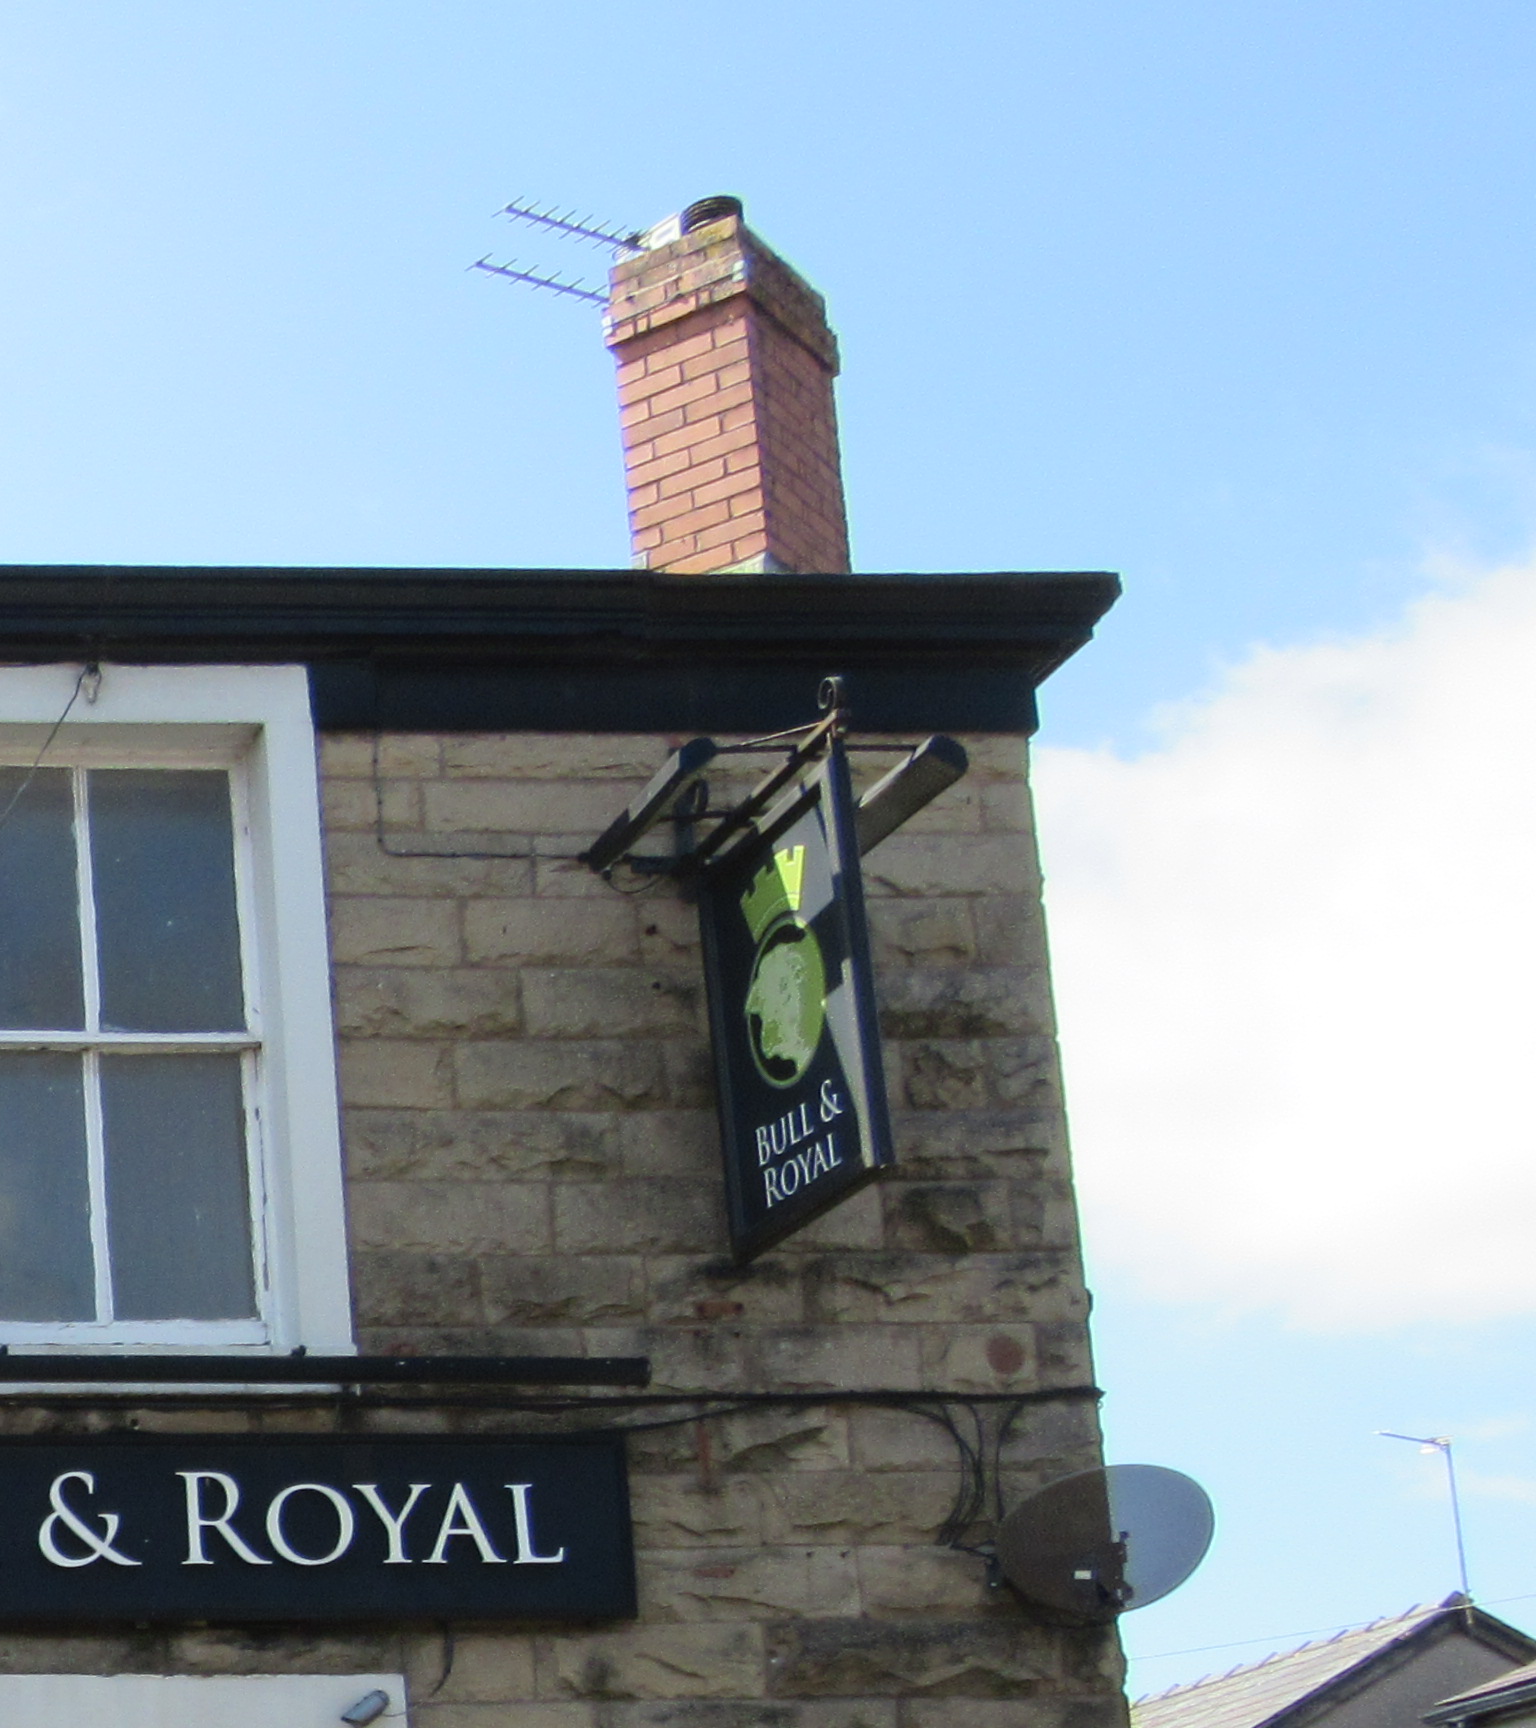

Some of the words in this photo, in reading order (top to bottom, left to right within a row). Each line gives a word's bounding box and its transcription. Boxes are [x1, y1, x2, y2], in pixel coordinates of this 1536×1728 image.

[755, 1102, 815, 1167] BULL
[820, 1079, 843, 1122] &
[763, 1133, 843, 1208] ROYAL
[38, 1470, 142, 1568] &
[175, 1471, 565, 1567] ROYAL
